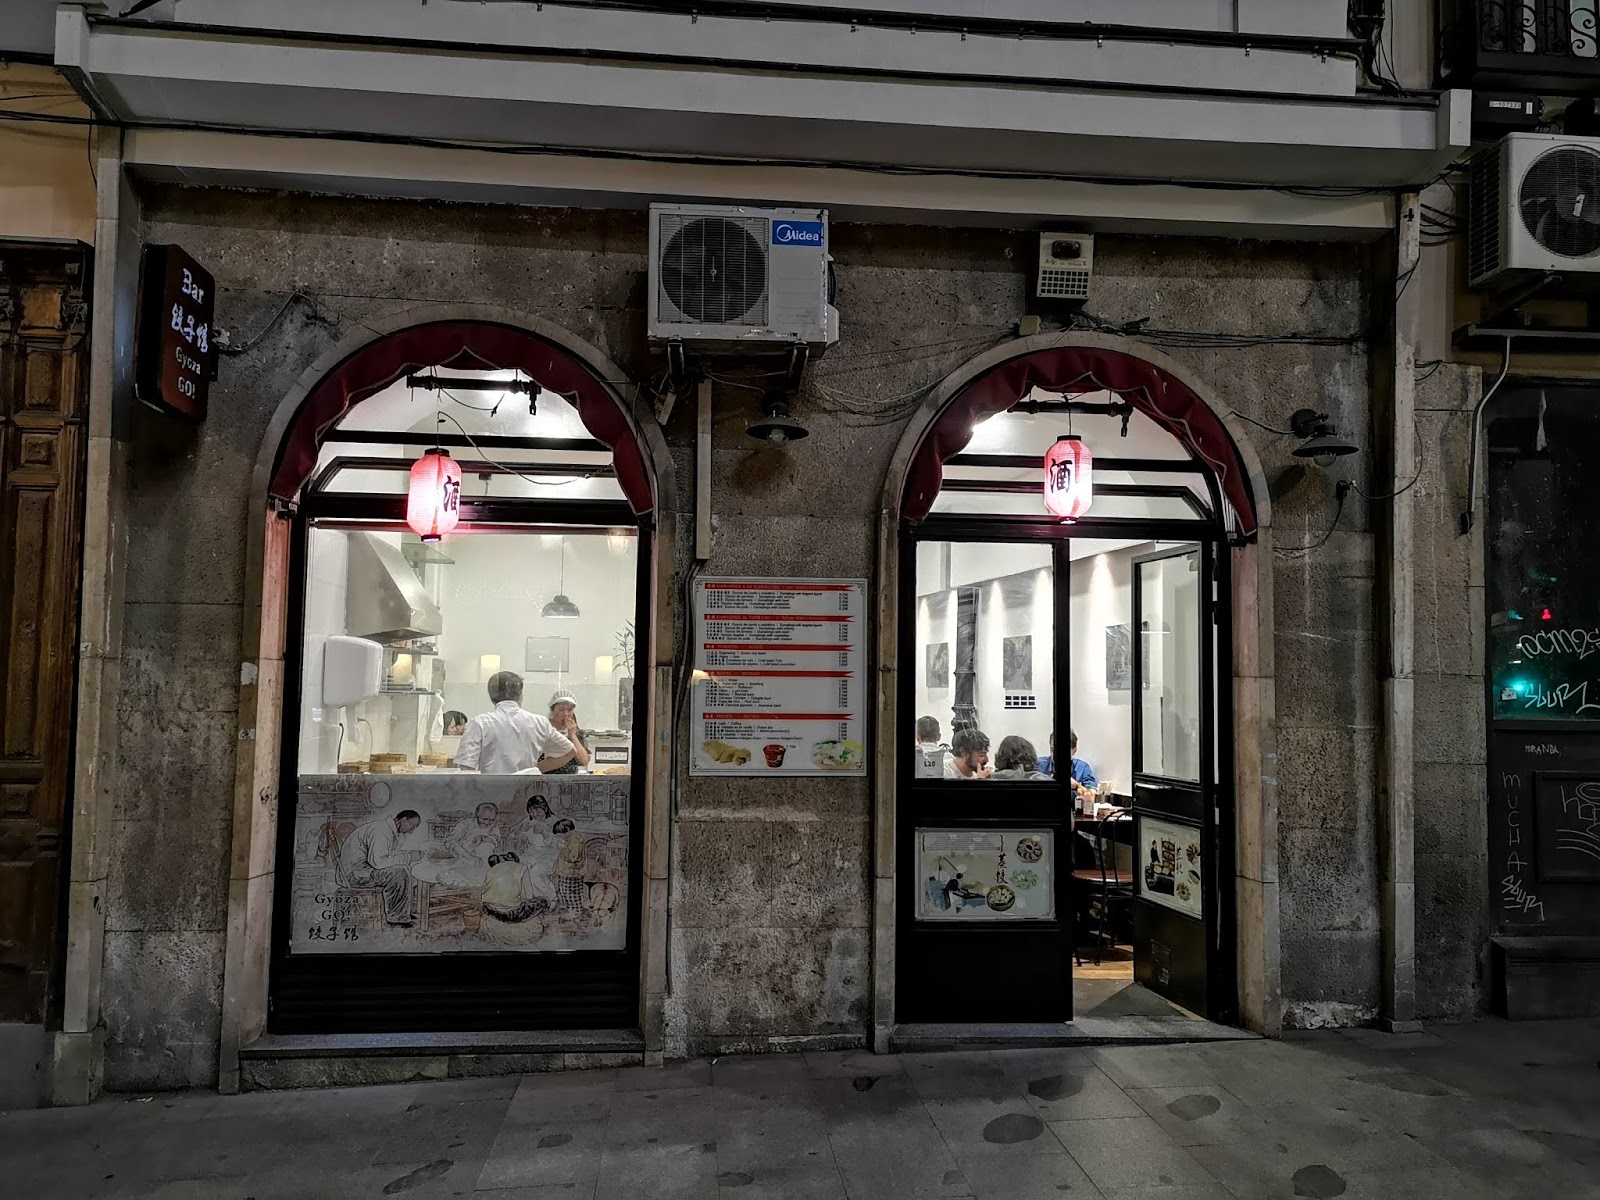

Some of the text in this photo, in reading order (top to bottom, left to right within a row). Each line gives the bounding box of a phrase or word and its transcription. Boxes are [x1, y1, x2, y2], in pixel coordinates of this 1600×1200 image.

[777, 225, 819, 241] Midea
[182, 267, 204, 304] Bar
[175, 346, 201, 375] Gyoza
[178, 376, 196, 399] GO!
[1049, 458, 1073, 493] 酒
[443, 475, 460, 515] 酒
[314, 893, 359, 906] Gyoza
[321, 909, 350, 921] GO!
[308, 924, 359, 941] 饺子馆
